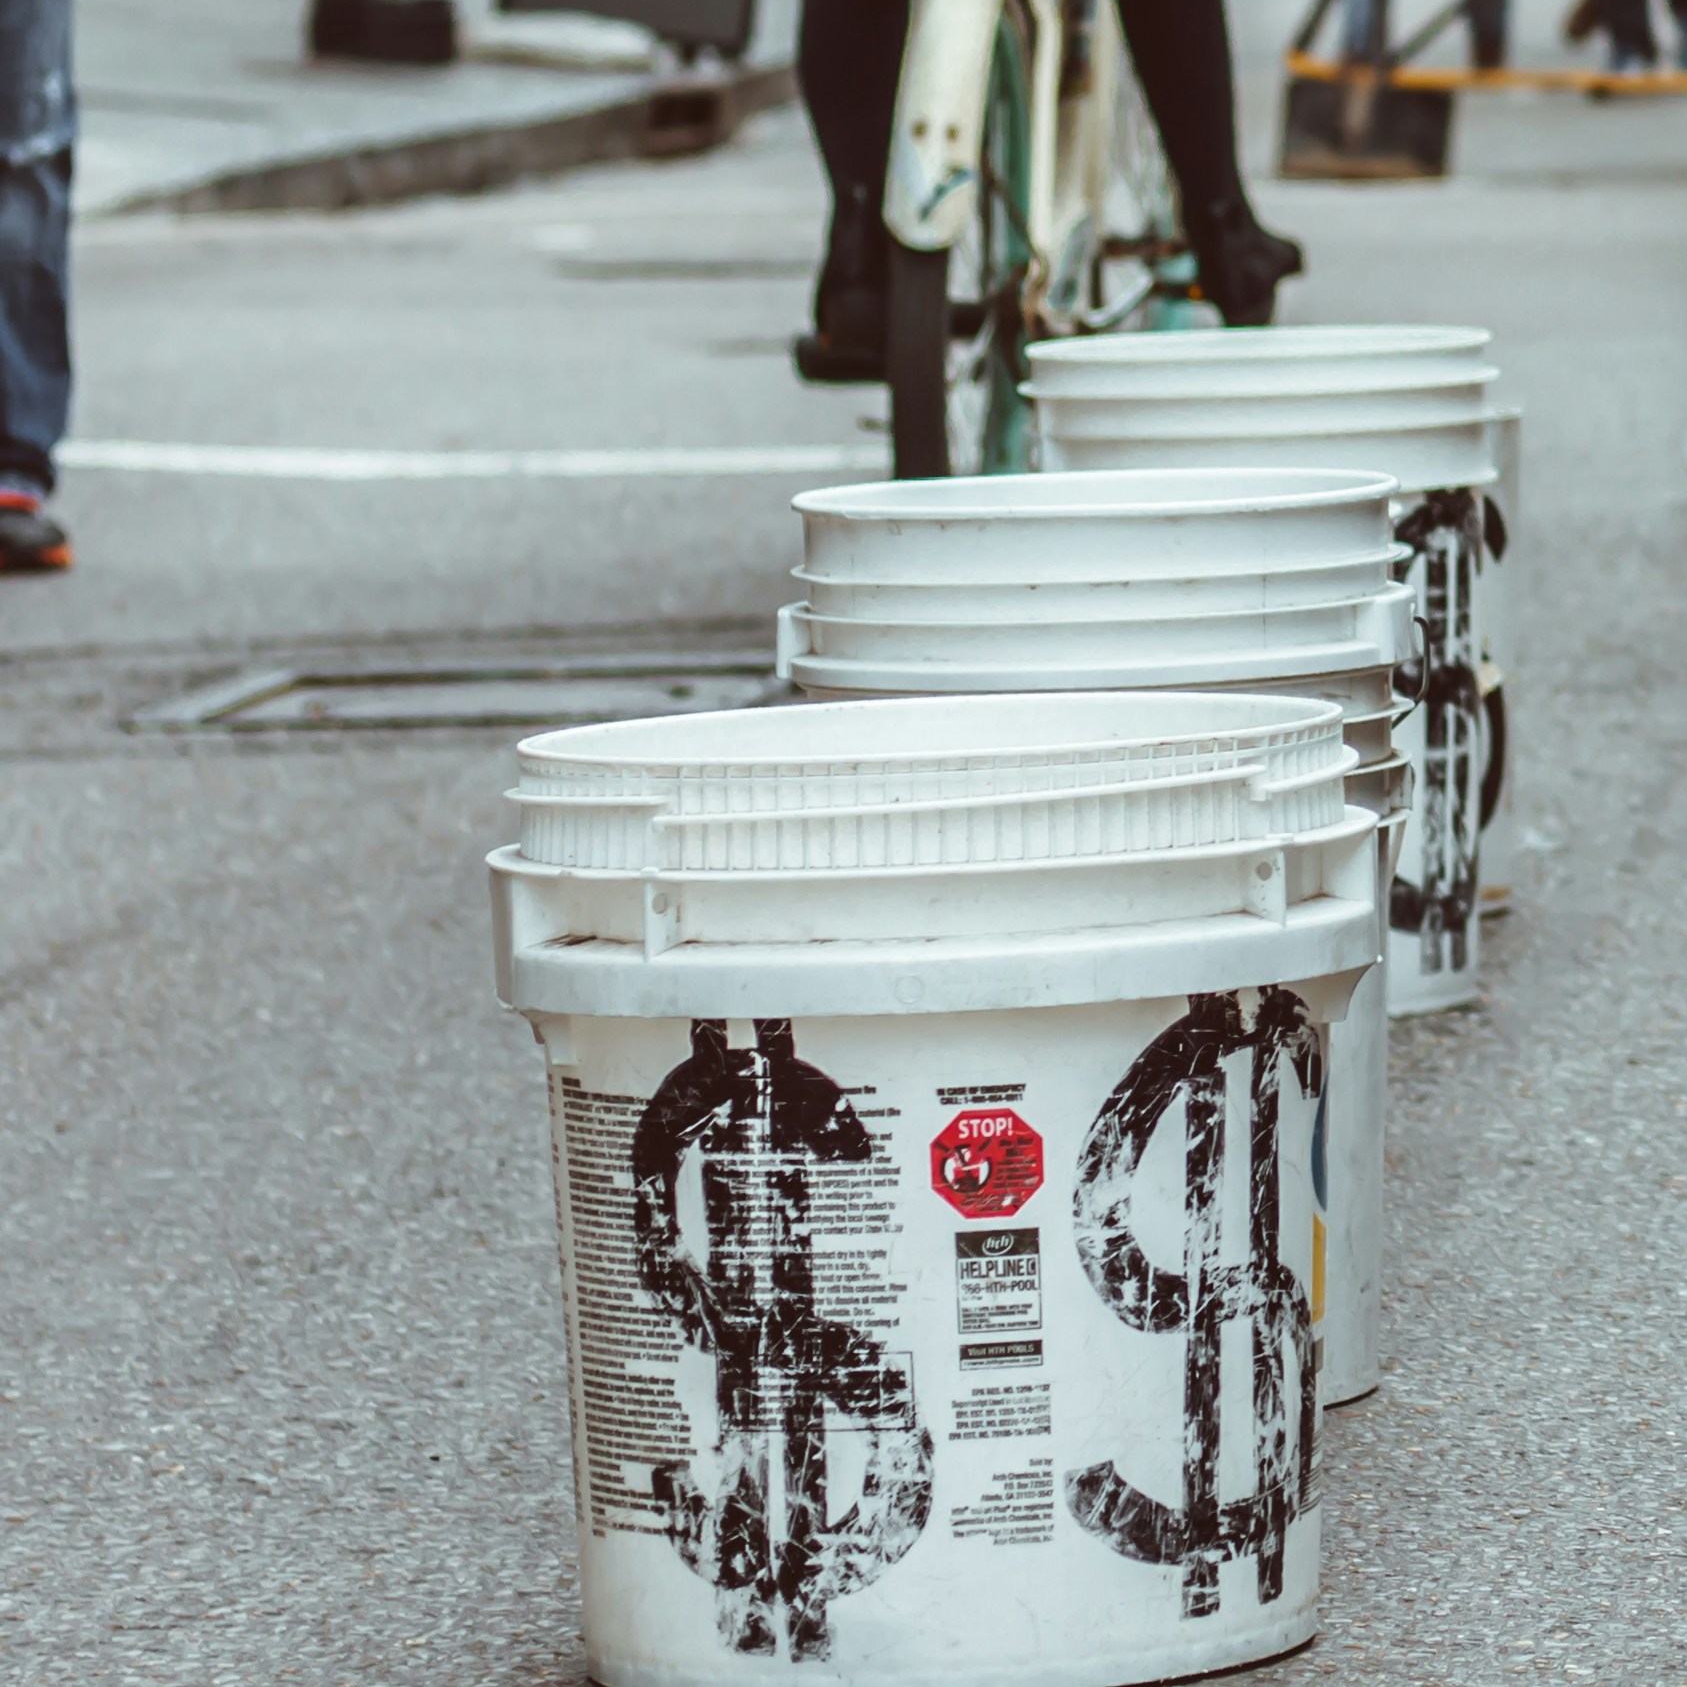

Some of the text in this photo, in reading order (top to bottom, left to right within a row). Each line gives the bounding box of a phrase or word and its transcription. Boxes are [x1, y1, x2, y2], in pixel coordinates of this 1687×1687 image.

[958, 1117, 1013, 1139] STOP!
[960, 1258, 1025, 1280] HELPLINE
[1007, 1344, 1034, 1353] POOLS
